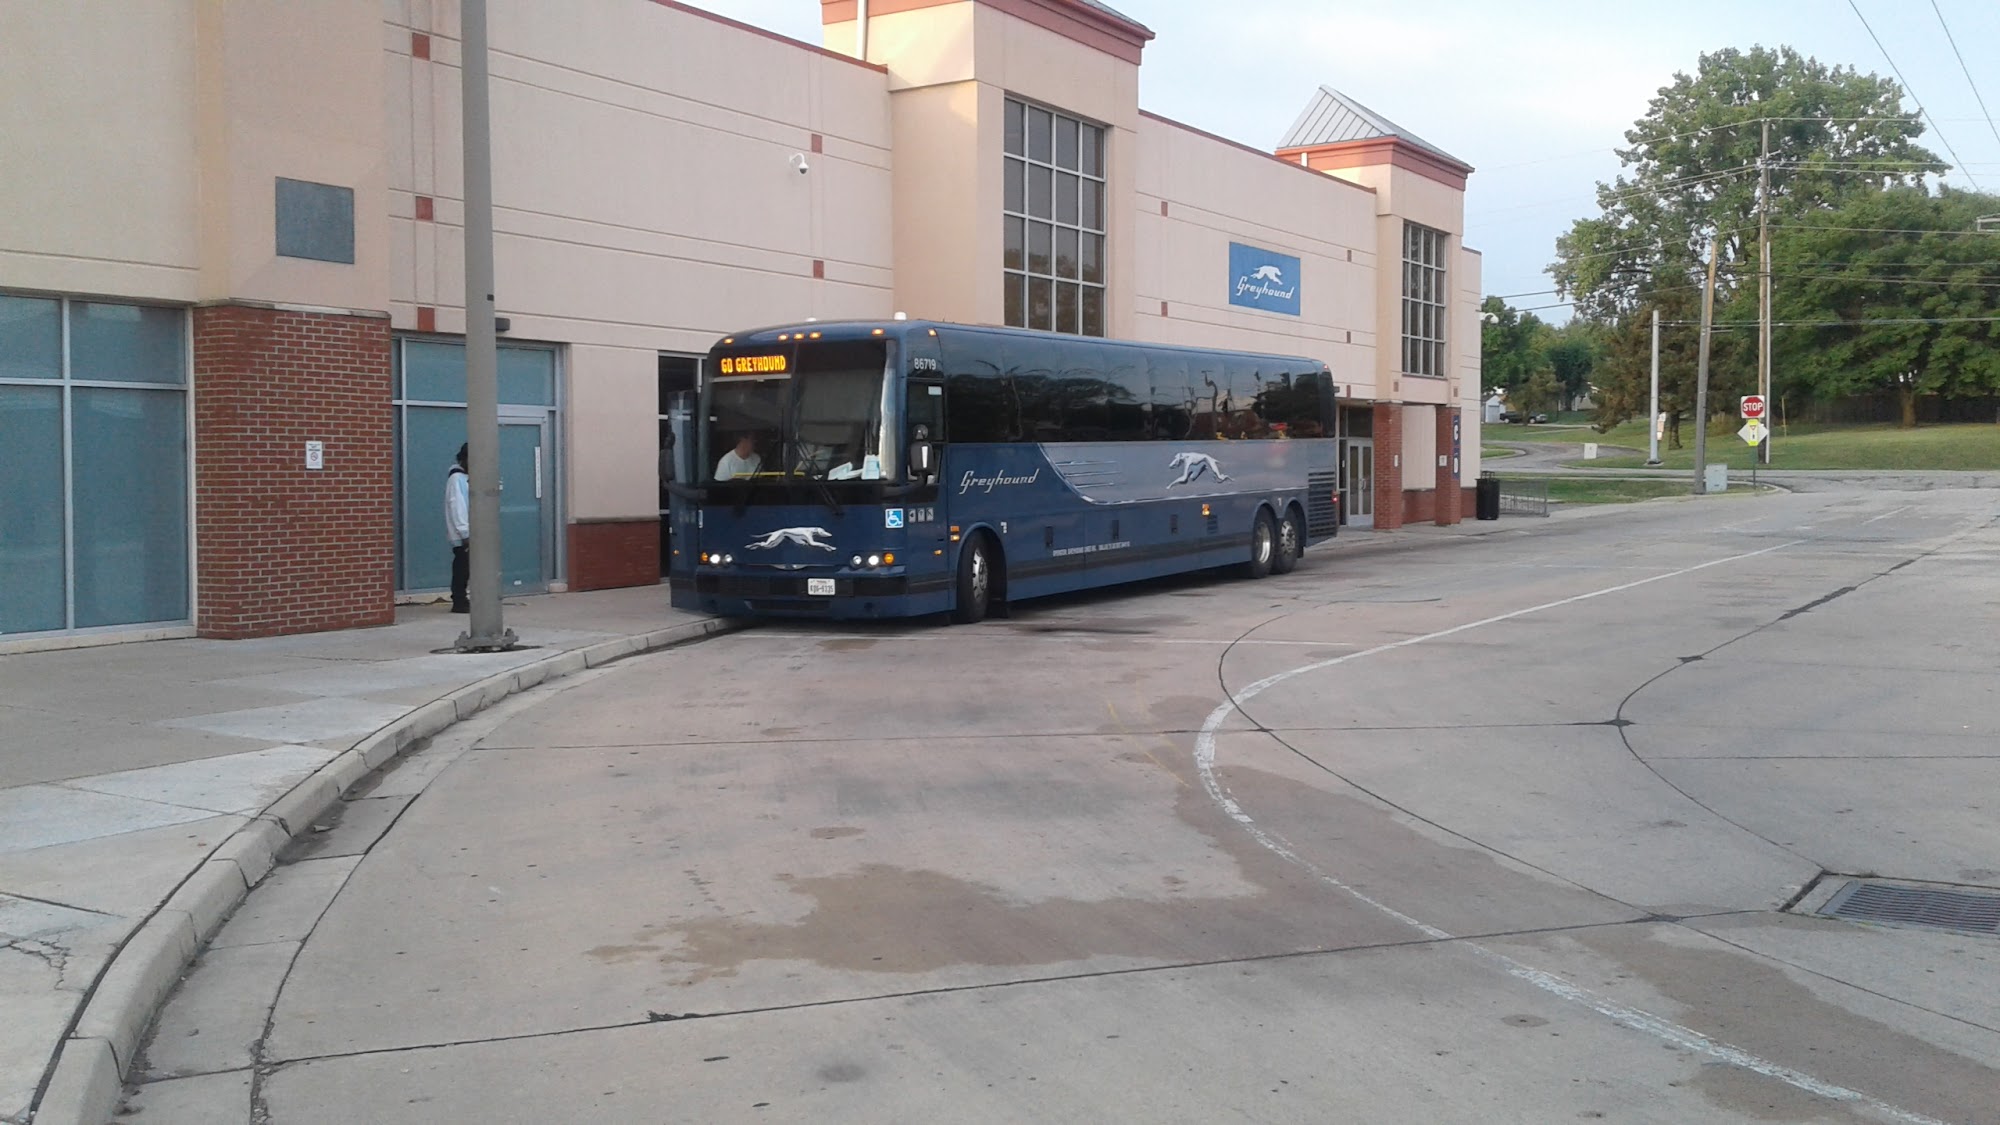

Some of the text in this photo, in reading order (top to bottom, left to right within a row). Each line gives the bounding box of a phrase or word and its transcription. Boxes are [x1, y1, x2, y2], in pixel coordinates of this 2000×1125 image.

[1236, 276, 1294, 299] Greyhound
[721, 355, 786, 373] GO GREYHOUND
[914, 358, 937, 370] 86719
[1743, 402, 1763, 411] STOP
[959, 468, 1040, 494] Greyhound
